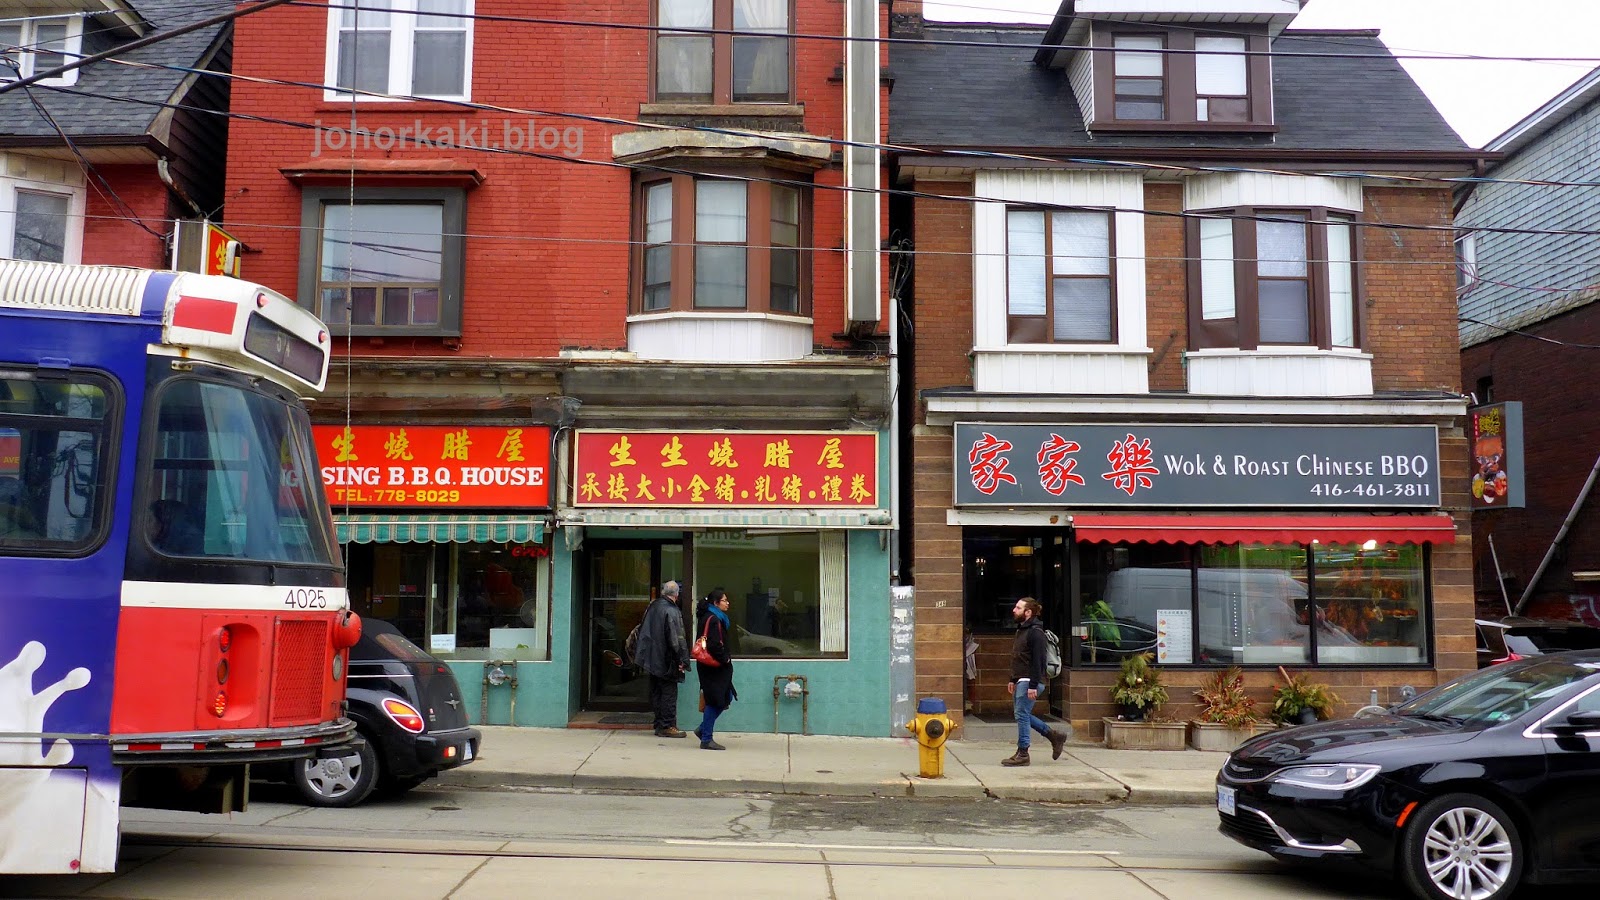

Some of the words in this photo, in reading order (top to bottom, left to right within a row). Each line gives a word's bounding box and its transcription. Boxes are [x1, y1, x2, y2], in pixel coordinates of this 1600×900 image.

[968, 432, 1160, 496] 家家樂
[1163, 454, 1206, 475] Wok
[1213, 454, 1227, 476] &
[1381, 455, 1428, 478] BBQ
[321, 466, 381, 485] SING
[387, 466, 456, 485] B.B.Q.
[460, 466, 543, 486] HOUSE
[334, 488, 460, 502] TEL:778-8029
[1310, 483, 1430, 496] 416-461-3811
[511, 546, 549, 557] OPEN
[285, 589, 327, 608] 4025
